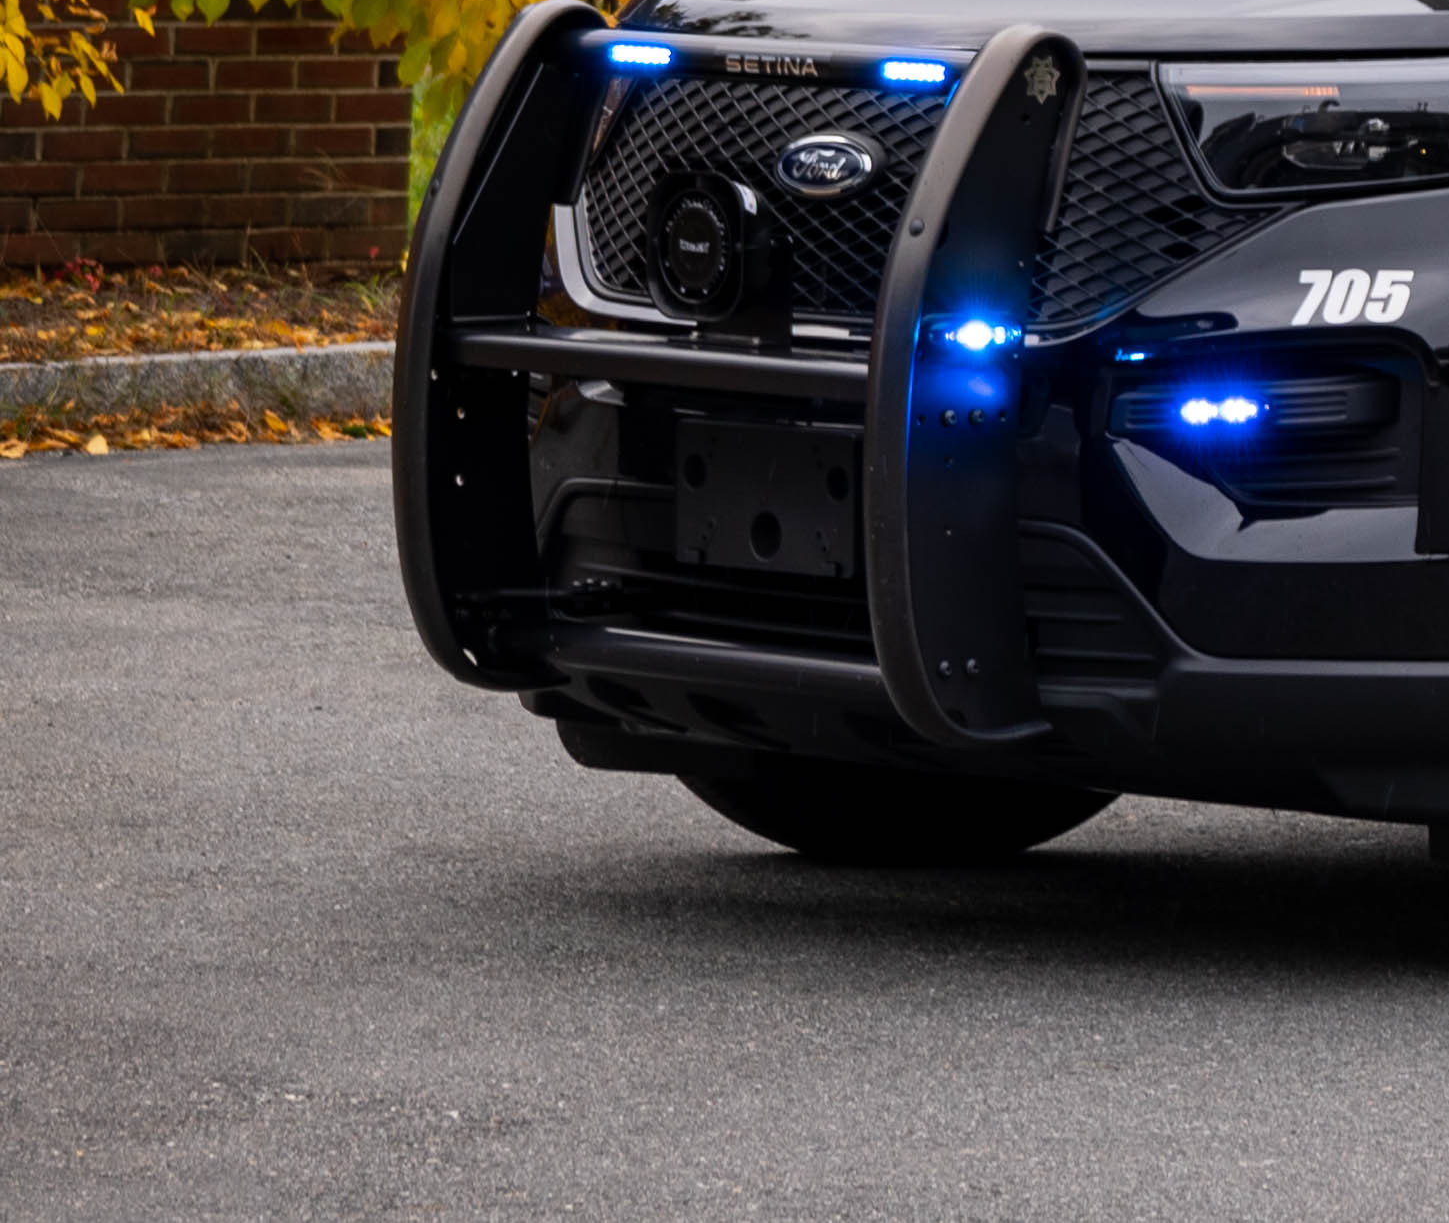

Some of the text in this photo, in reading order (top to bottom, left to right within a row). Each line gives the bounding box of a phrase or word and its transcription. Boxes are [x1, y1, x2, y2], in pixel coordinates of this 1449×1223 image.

[725, 54, 818, 76] SETINA
[791, 149, 848, 180] Ford
[1291, 268, 1415, 326] 705
